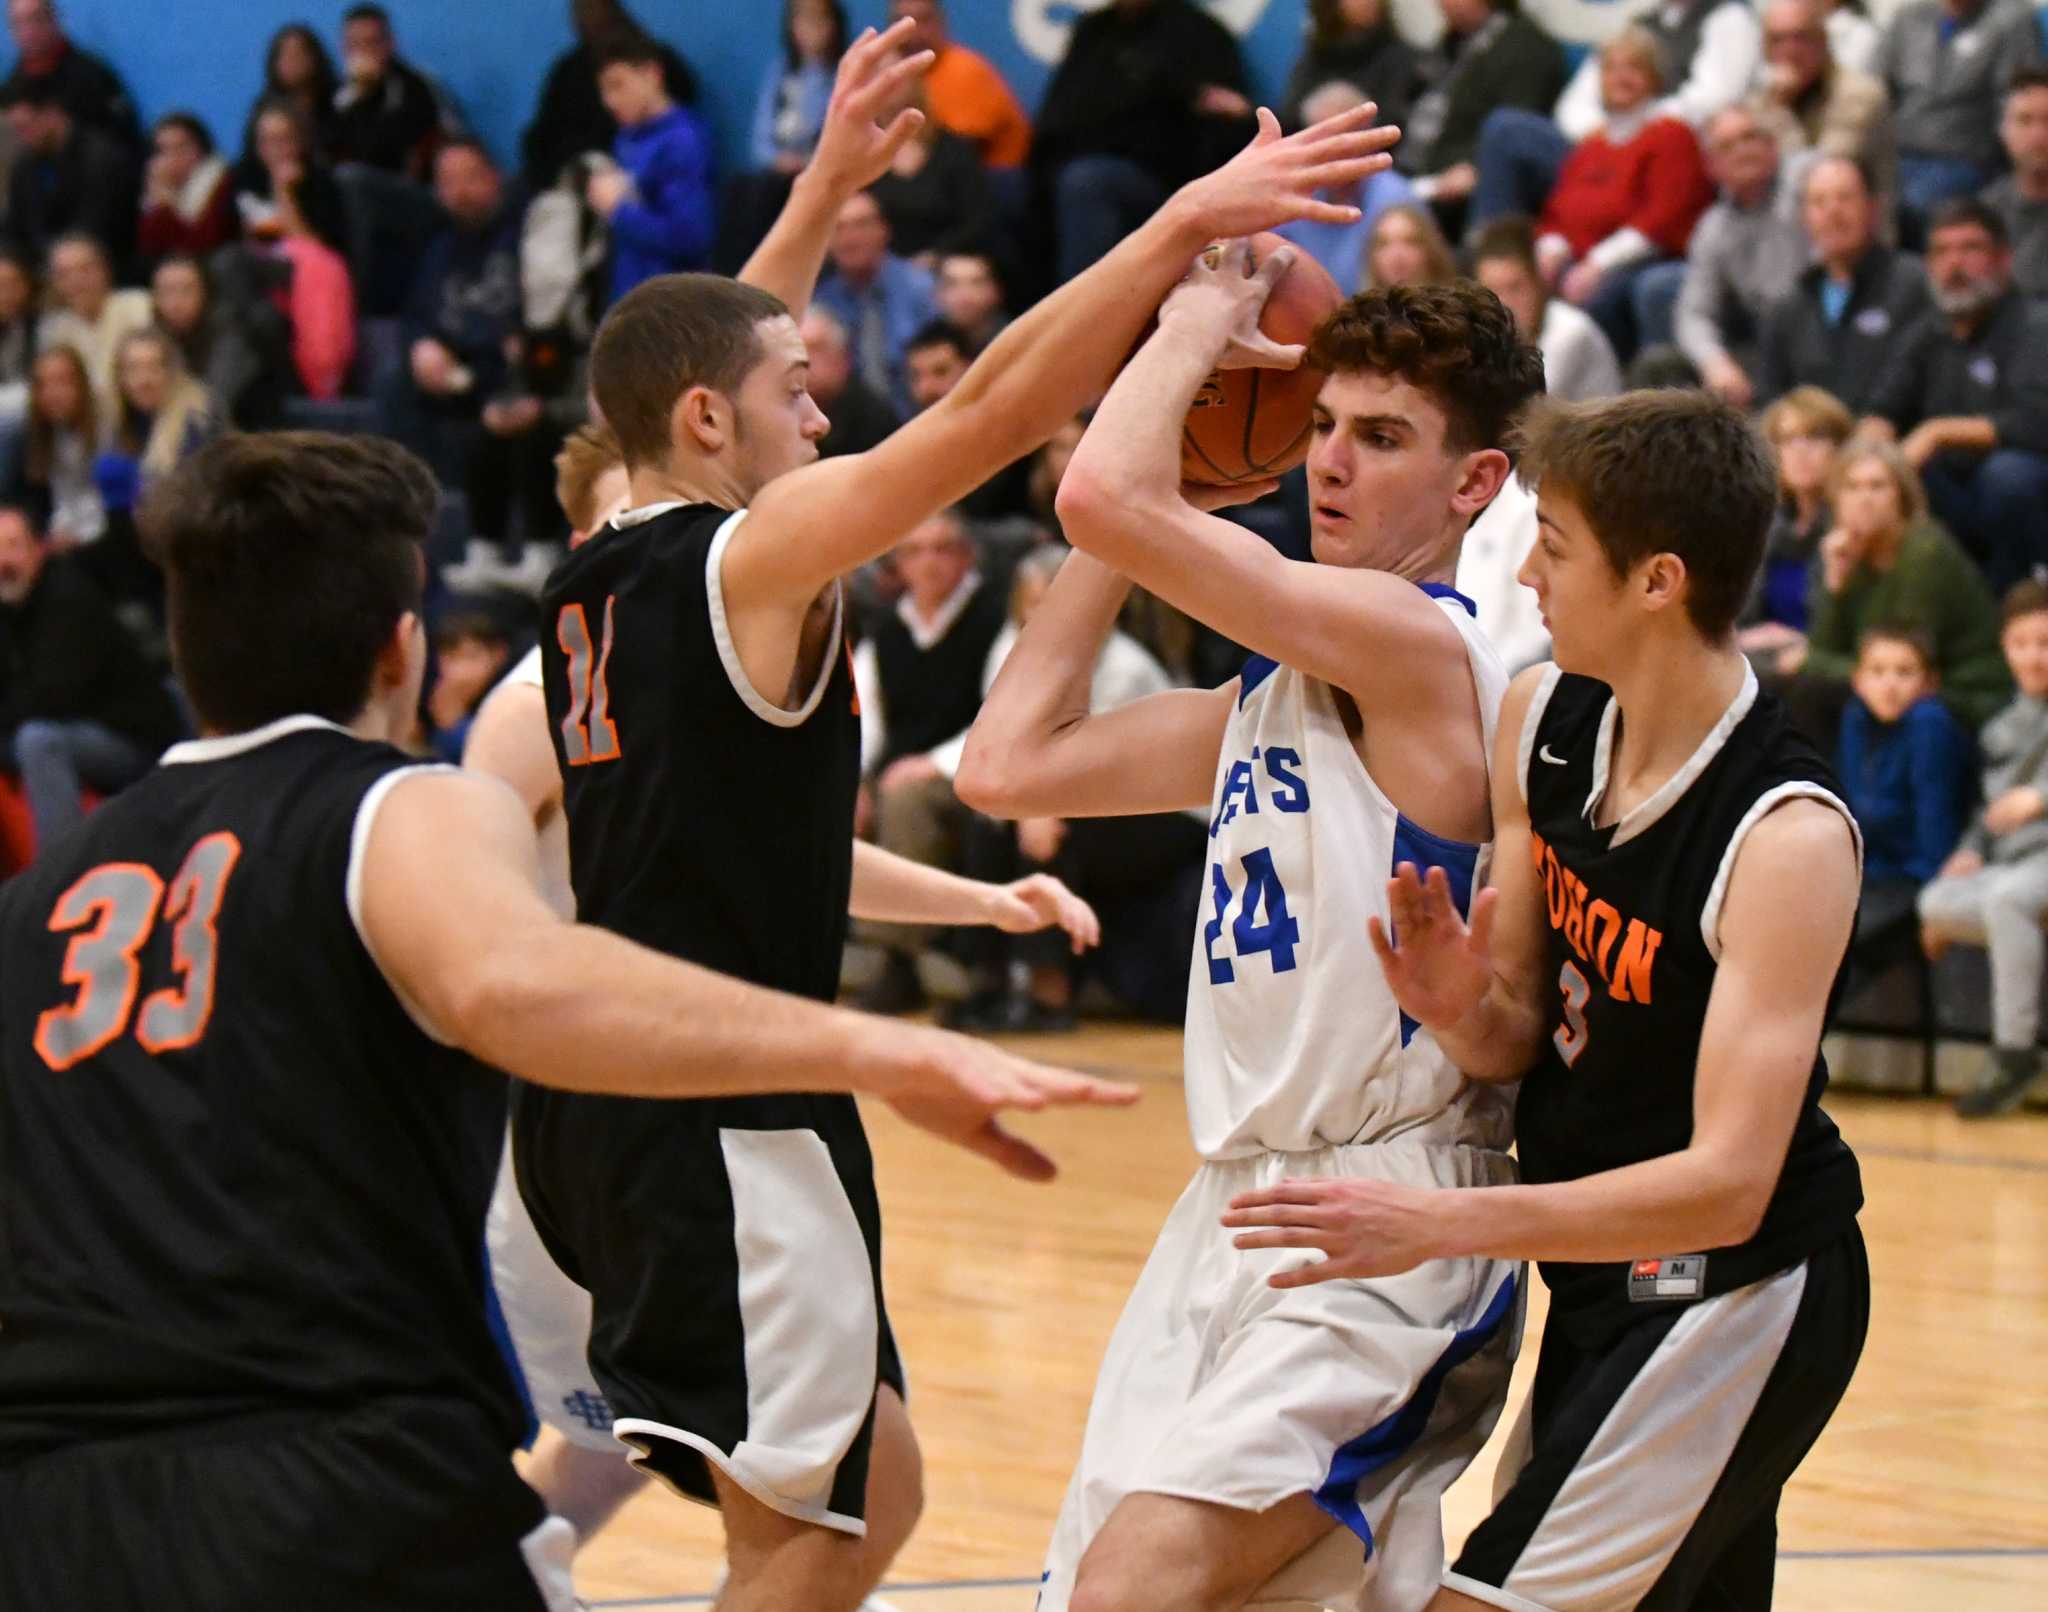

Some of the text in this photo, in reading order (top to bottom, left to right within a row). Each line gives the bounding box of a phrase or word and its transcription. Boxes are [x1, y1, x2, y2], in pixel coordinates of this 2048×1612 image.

[556, 594, 623, 766] 11
[33, 830, 242, 1072] 33
[1553, 959, 1591, 1070] 3
